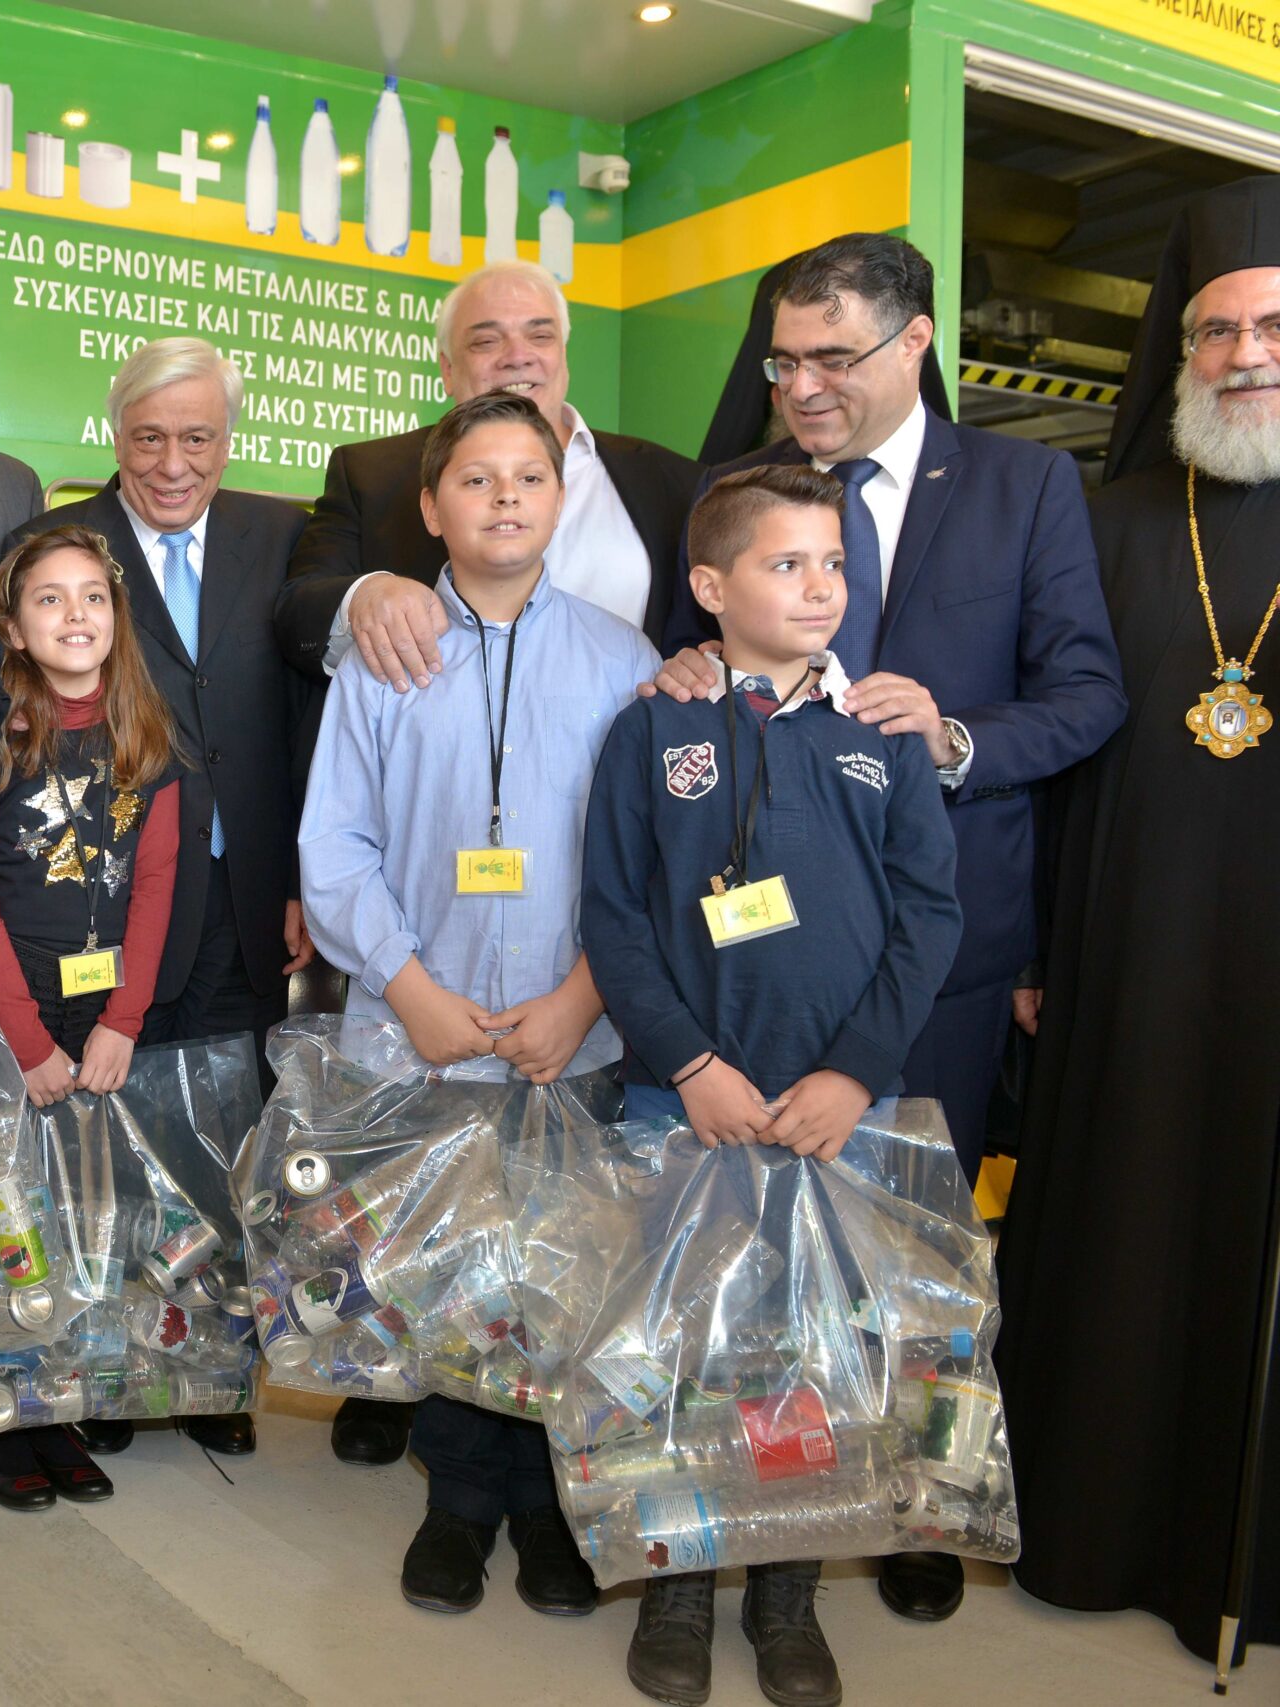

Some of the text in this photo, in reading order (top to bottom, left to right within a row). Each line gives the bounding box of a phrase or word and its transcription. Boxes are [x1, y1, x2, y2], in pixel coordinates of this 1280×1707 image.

[54, 239, 206, 289] ΦΕΡΝΟΥΜΕ
[214, 263, 369, 314] ΜΕΤΑΛΛΙΚΕΣ
[376, 289, 391, 317] &
[13, 276, 189, 328] ΣΥΣΚΕΥΑΣΙΕΣ
[197, 302, 239, 335] ΚΑΙ
[247, 309, 284, 342] ΤΙΣ
[265, 353, 324, 388] ΜΑΖΙ
[332, 363, 368, 393] ΜΕ
[373, 368, 402, 398] ΤΟ
[409, 373, 448, 403] ΠΙΟ
[241, 392, 420, 436] ΙΑΚΟ ΣΥΣΤΗΜΑ
[668, 751, 685, 761] EST.
[861, 763, 881, 780] 1982
